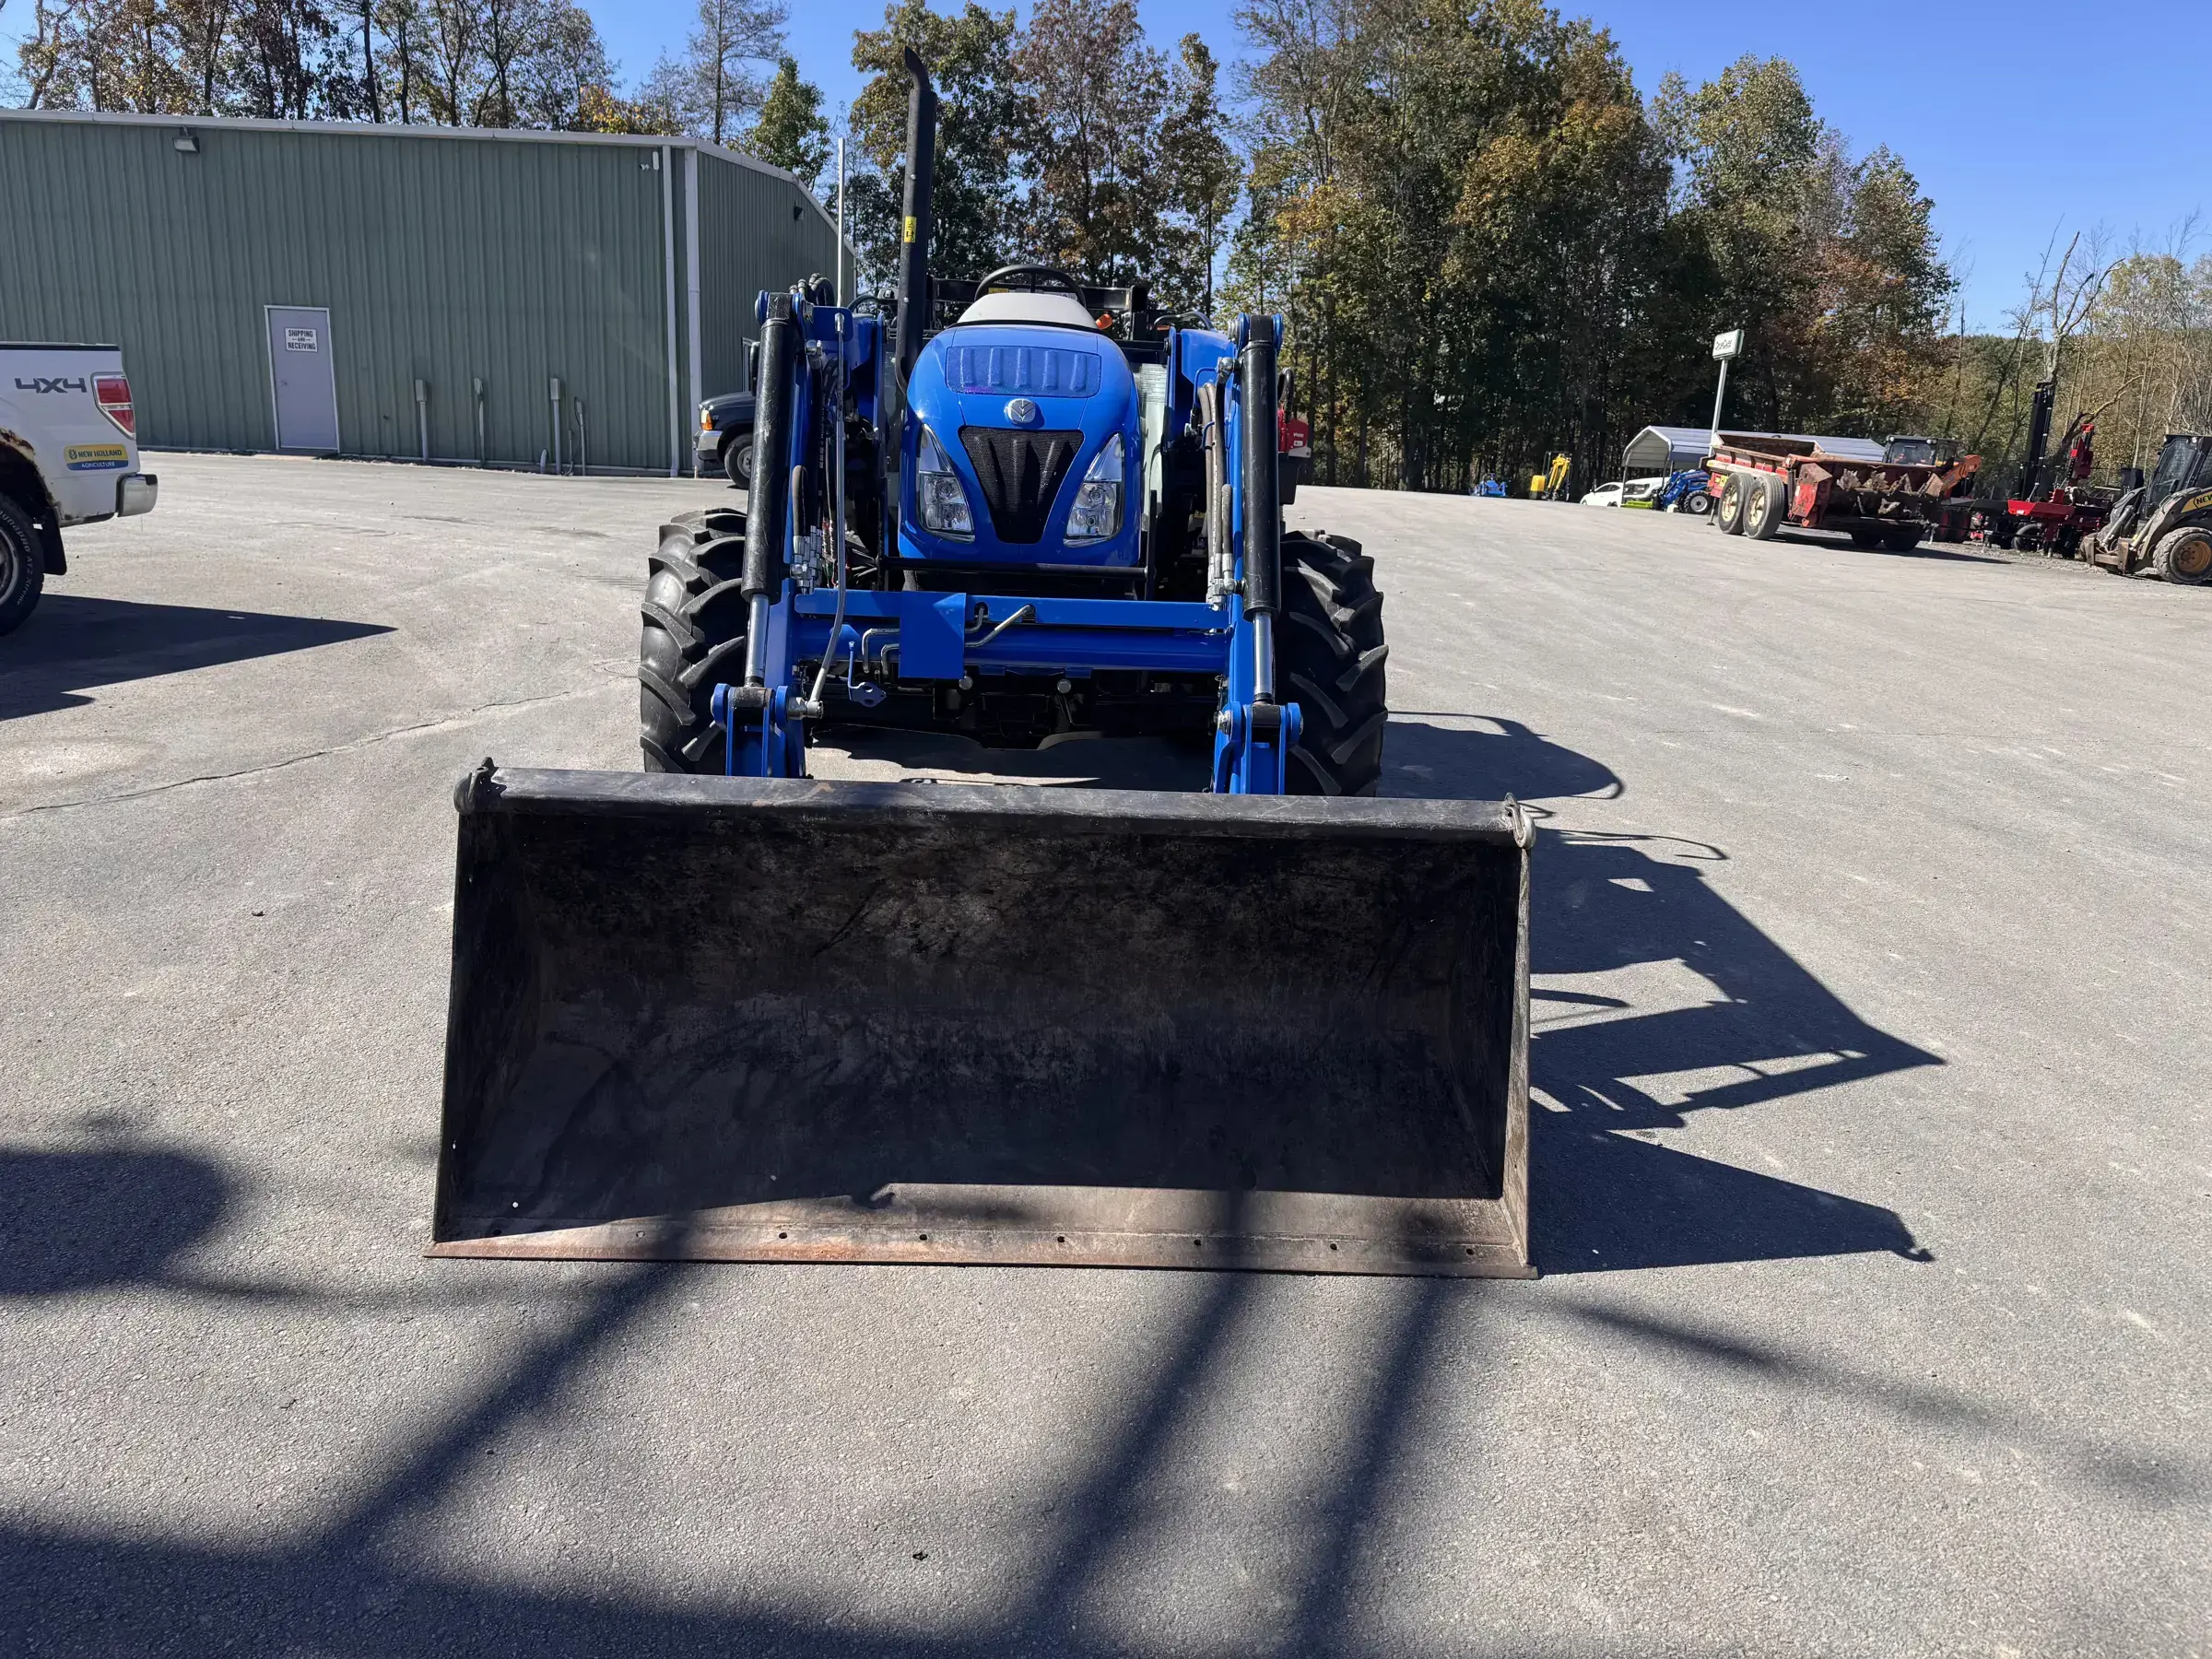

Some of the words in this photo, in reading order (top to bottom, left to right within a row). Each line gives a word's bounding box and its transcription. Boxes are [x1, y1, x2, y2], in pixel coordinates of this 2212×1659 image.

[288, 329, 313, 337] SHIPPING
[288, 342, 316, 350] RECEIVING
[77, 450, 93, 458] NEW
[93, 449, 123, 457] HOLLAND
